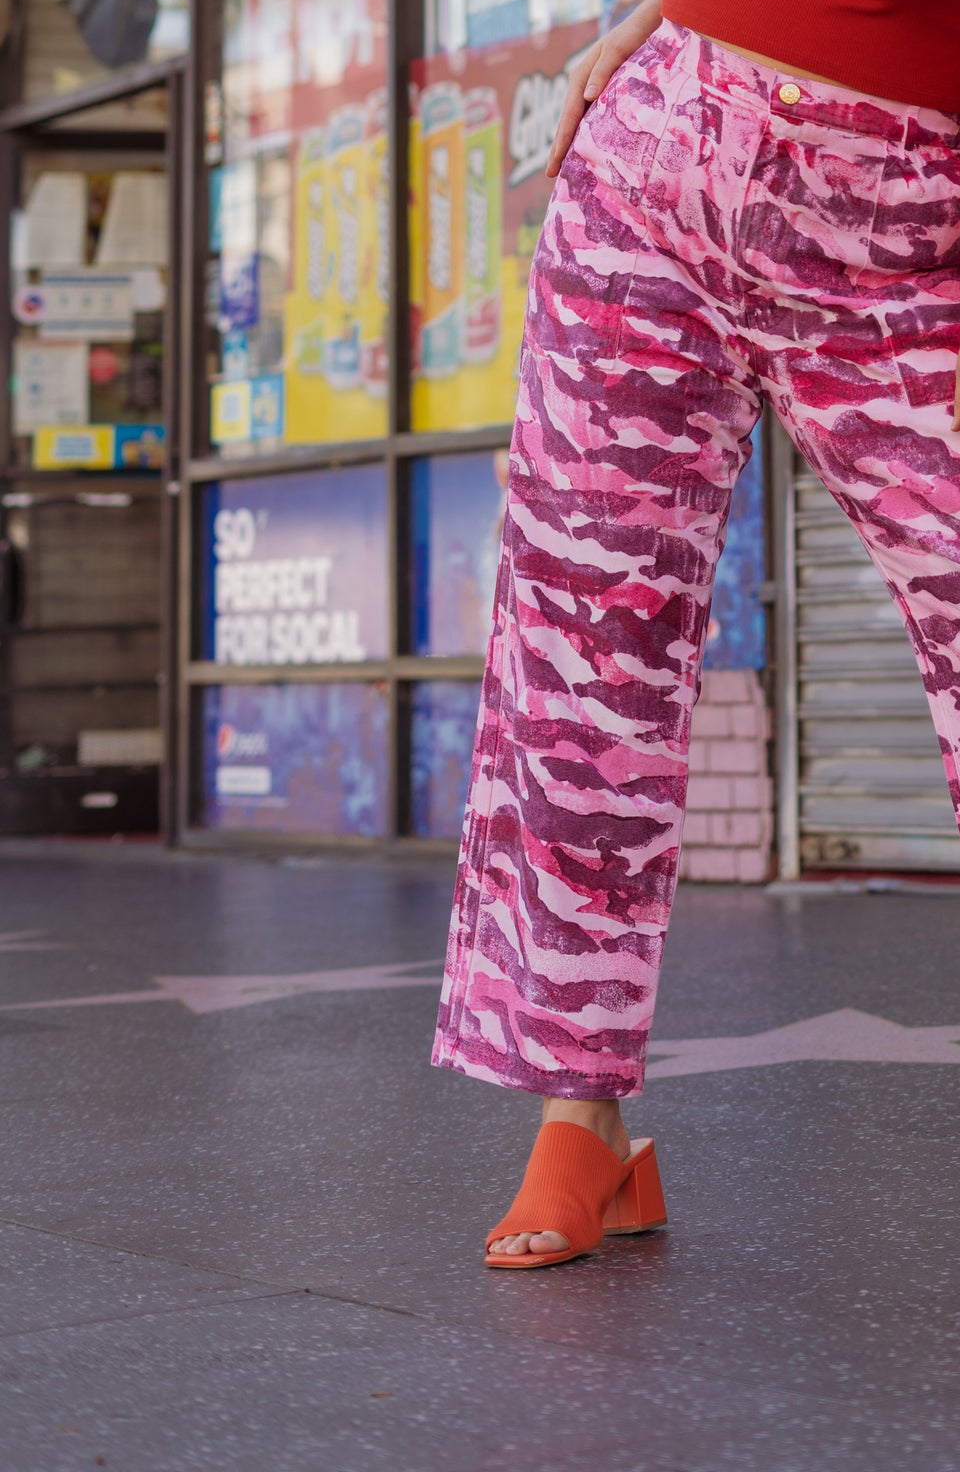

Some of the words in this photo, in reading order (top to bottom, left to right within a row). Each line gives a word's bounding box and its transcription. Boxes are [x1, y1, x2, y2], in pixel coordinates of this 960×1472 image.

[215, 556, 332, 614] PERFECT
[215, 613, 269, 666] FOR
[270, 610, 367, 666] SOCAL
